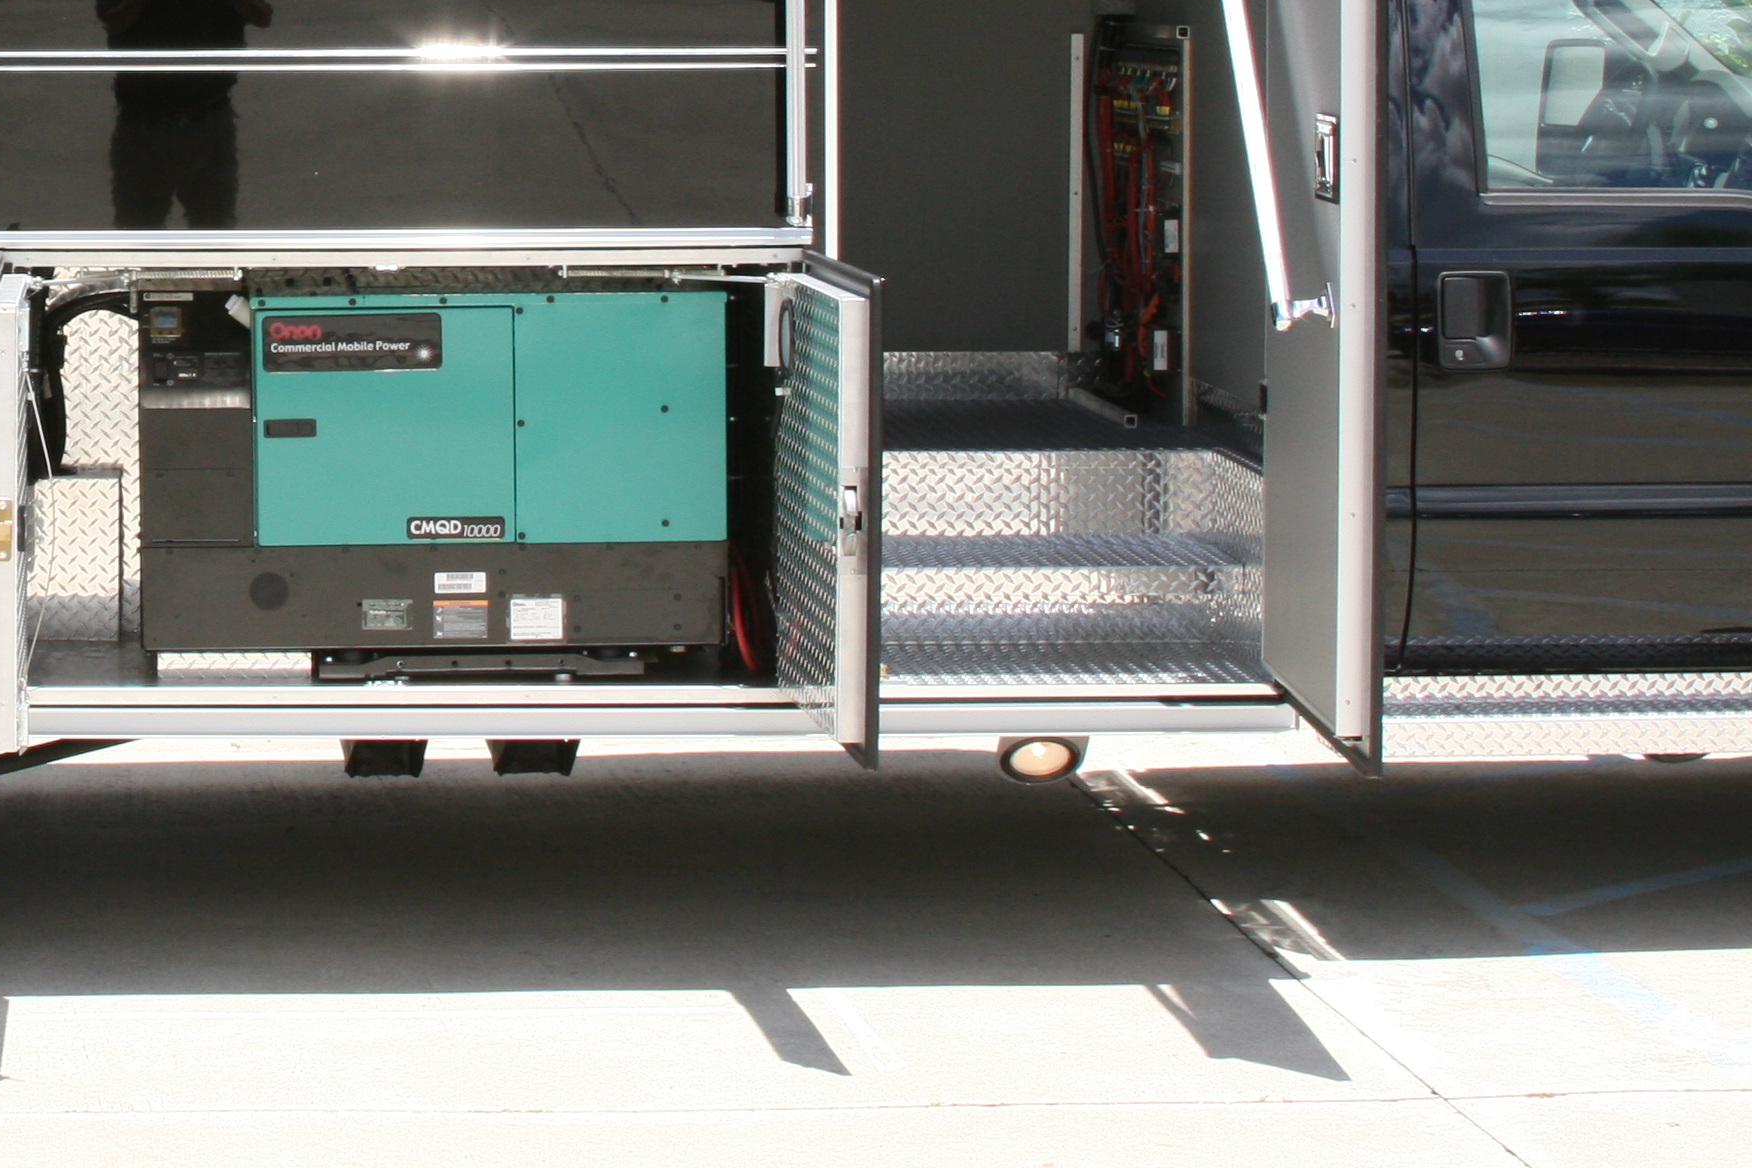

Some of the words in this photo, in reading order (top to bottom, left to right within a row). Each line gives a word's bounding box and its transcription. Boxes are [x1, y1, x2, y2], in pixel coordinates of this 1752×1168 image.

[269, 322, 322, 340] Onan
[270, 342, 336, 353] Commercial
[337, 341, 374, 351] Mobile
[375, 341, 411, 351] Power
[410, 520, 462, 535] CMQD
[463, 524, 501, 537] 10000
